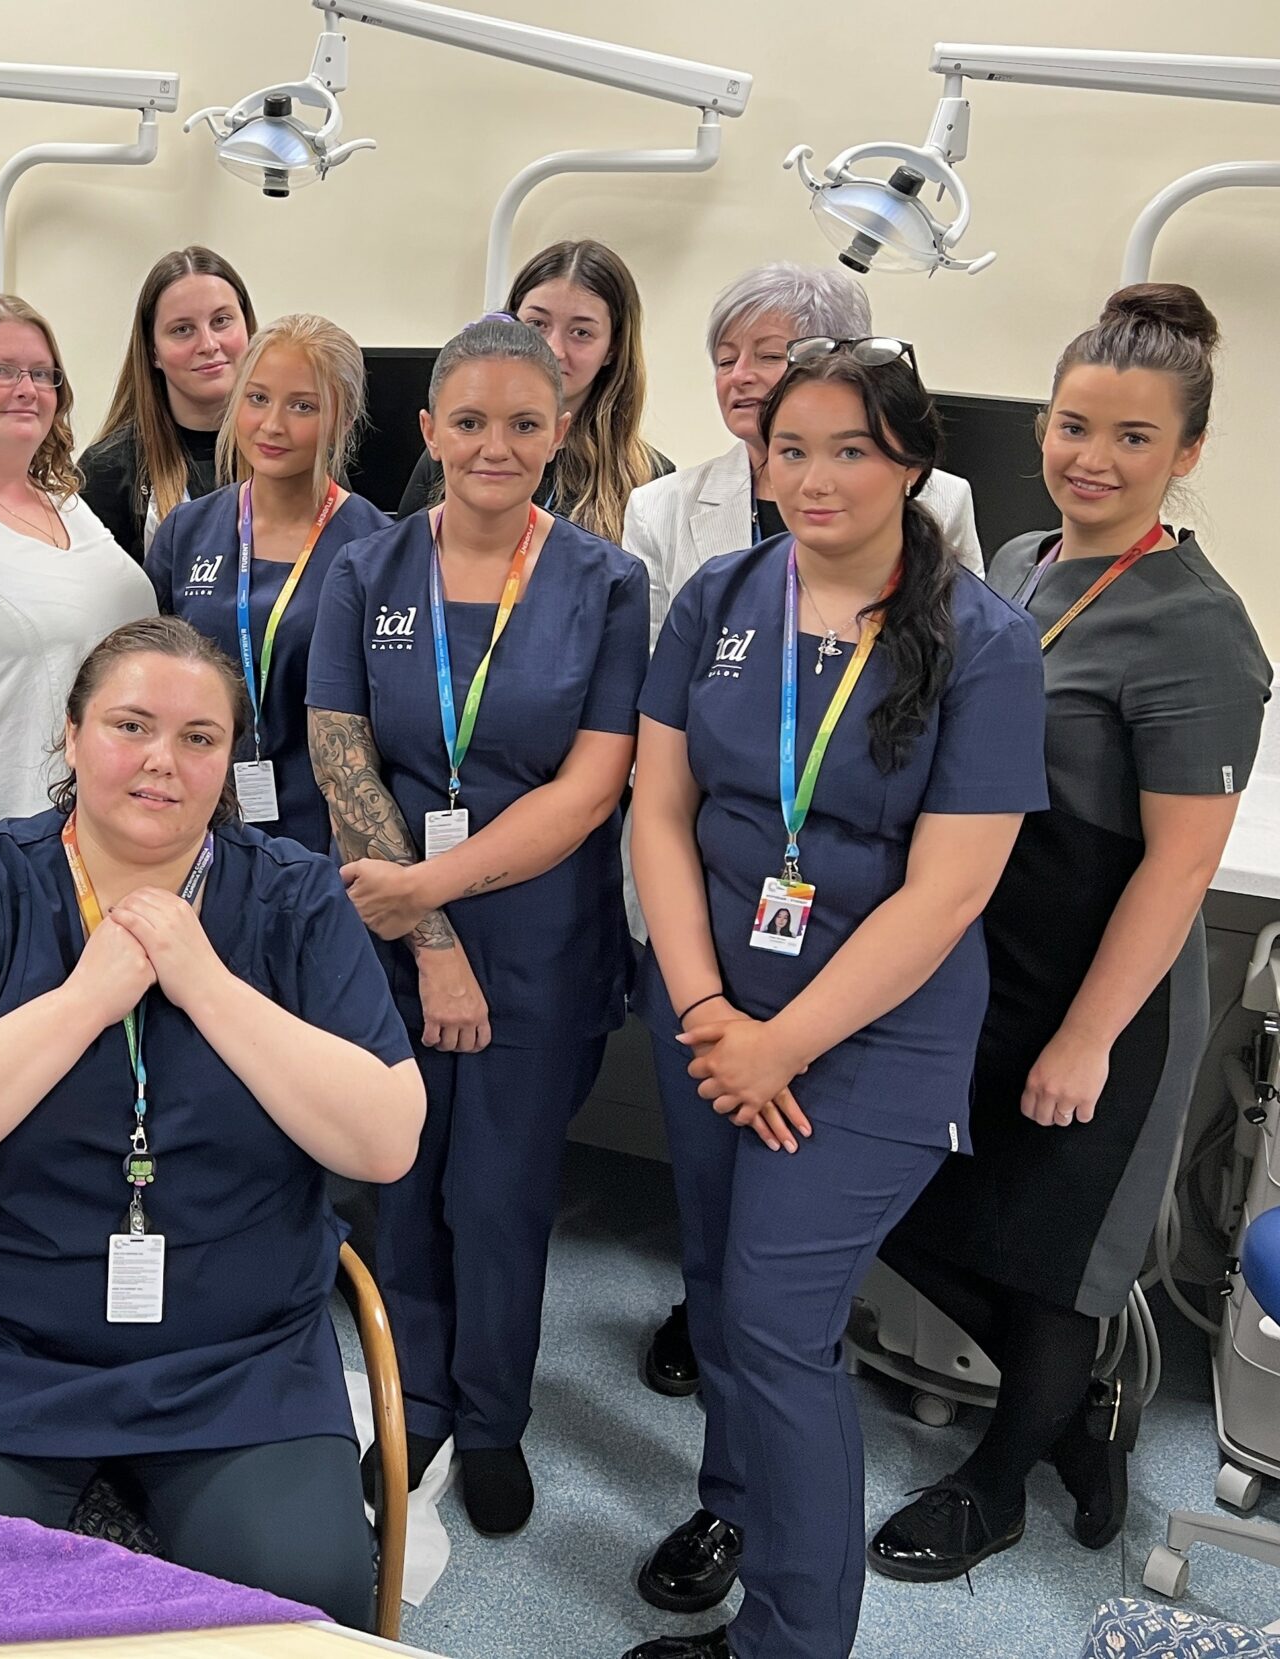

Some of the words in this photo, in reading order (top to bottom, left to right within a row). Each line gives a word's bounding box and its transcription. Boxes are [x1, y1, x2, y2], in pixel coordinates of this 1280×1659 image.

[190, 555, 223, 582] iâl
[241, 543, 249, 573] STUDENT
[375, 605, 417, 636] iâl
[715, 626, 756, 661] iâl
